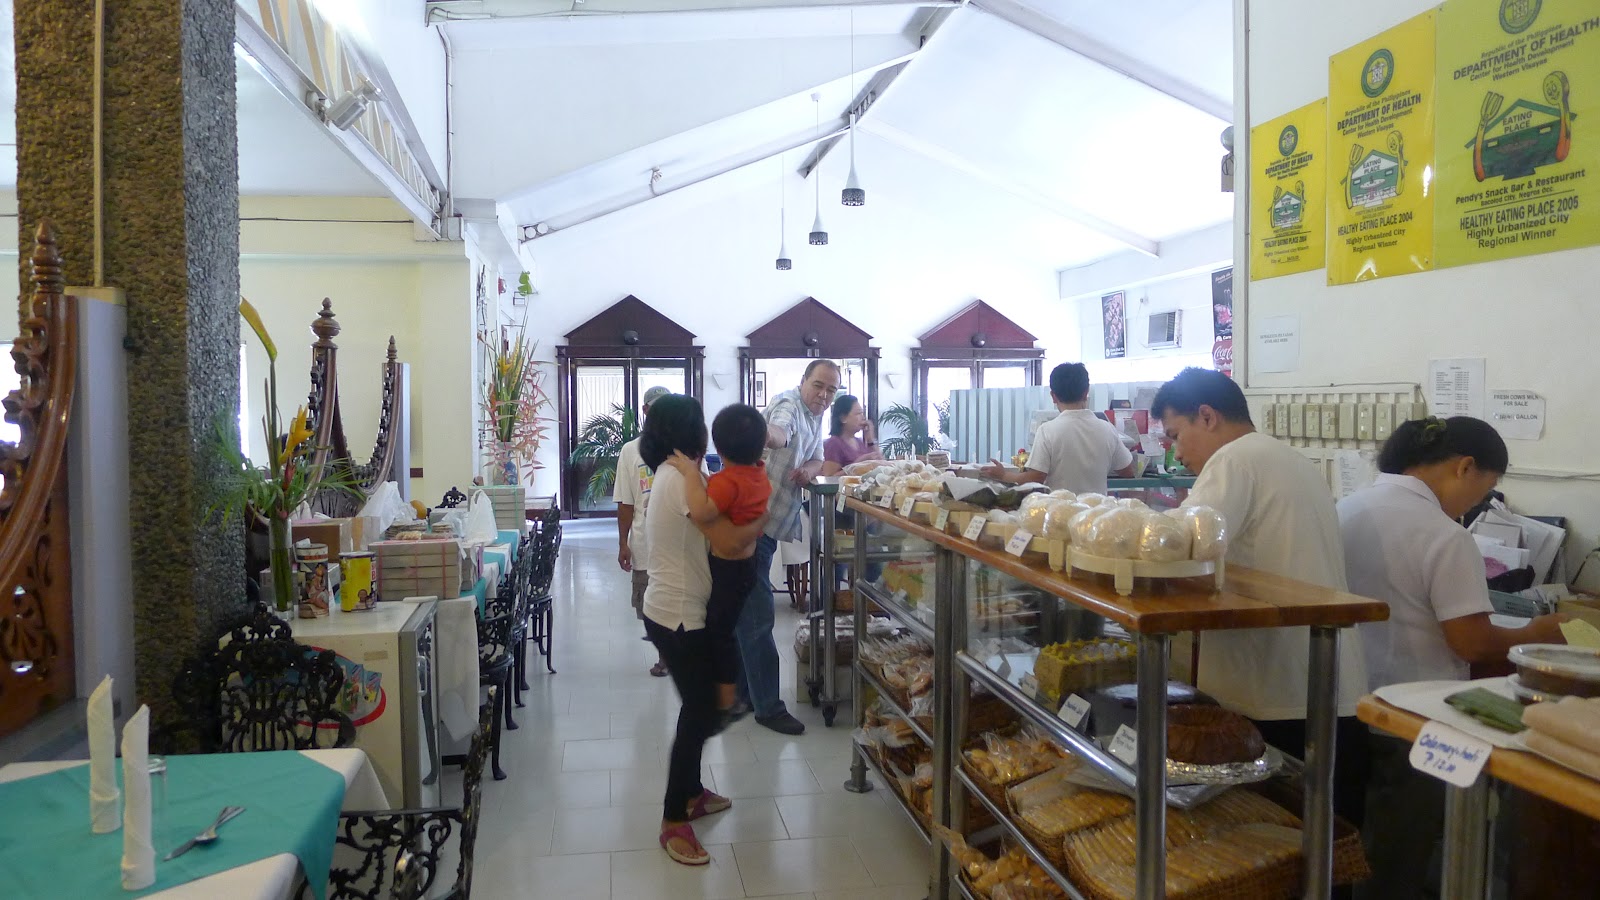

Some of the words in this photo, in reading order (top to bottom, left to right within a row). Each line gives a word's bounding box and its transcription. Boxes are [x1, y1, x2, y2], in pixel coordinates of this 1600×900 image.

[1454, 45, 1527, 80] DEPARTMENT
[1531, 38, 1545, 51] OF
[1550, 18, 1600, 45] HEALTH
[1515, 38, 1525, 46] the
[1470, 70, 1490, 82] Center
[1493, 64, 1502, 72] for
[1504, 55, 1525, 69] Health
[1528, 39, 1574, 61] Development
[1493, 69, 1519, 81] Western
[1522, 58, 1547, 72] Visayas
[1337, 108, 1380, 130] DEPARTMENT
[1382, 104, 1390, 114] OF
[1393, 94, 1421, 111] HEALTH
[1503, 111, 1532, 126] EATING
[1504, 120, 1530, 134] PLACE
[1363, 159, 1382, 168] EATING
[1364, 165, 1380, 174] PLACE
[1456, 192, 1483, 204] Pendy's
[1486, 186, 1508, 198] Snack
[1511, 183, 1525, 193] Bar
[1527, 180, 1533, 189] &
[1536, 169, 1586, 187] Restaurant
[1338, 224, 1358, 236] HEALTHY
[1360, 220, 1378, 231] EATING
[1380, 215, 1397, 227] PLACE
[1399, 211, 1413, 223] 2004
[1460, 212, 1494, 230] HEALTHY
[1496, 207, 1525, 223] EATING
[1528, 200, 1555, 218] PLACE
[1558, 196, 1579, 212] 2005
[1467, 227, 1495, 239] Highly
[1498, 216, 1546, 234] Urbanized
[1549, 213, 1570, 224] City
[1346, 236, 1362, 245] Highly
[1364, 231, 1392, 241] Urbanized
[1353, 243, 1376, 253] Regional
[1378, 240, 1397, 248] Winner
[1479, 234, 1518, 248] Regional
[1521, 228, 1556, 241] Winner
